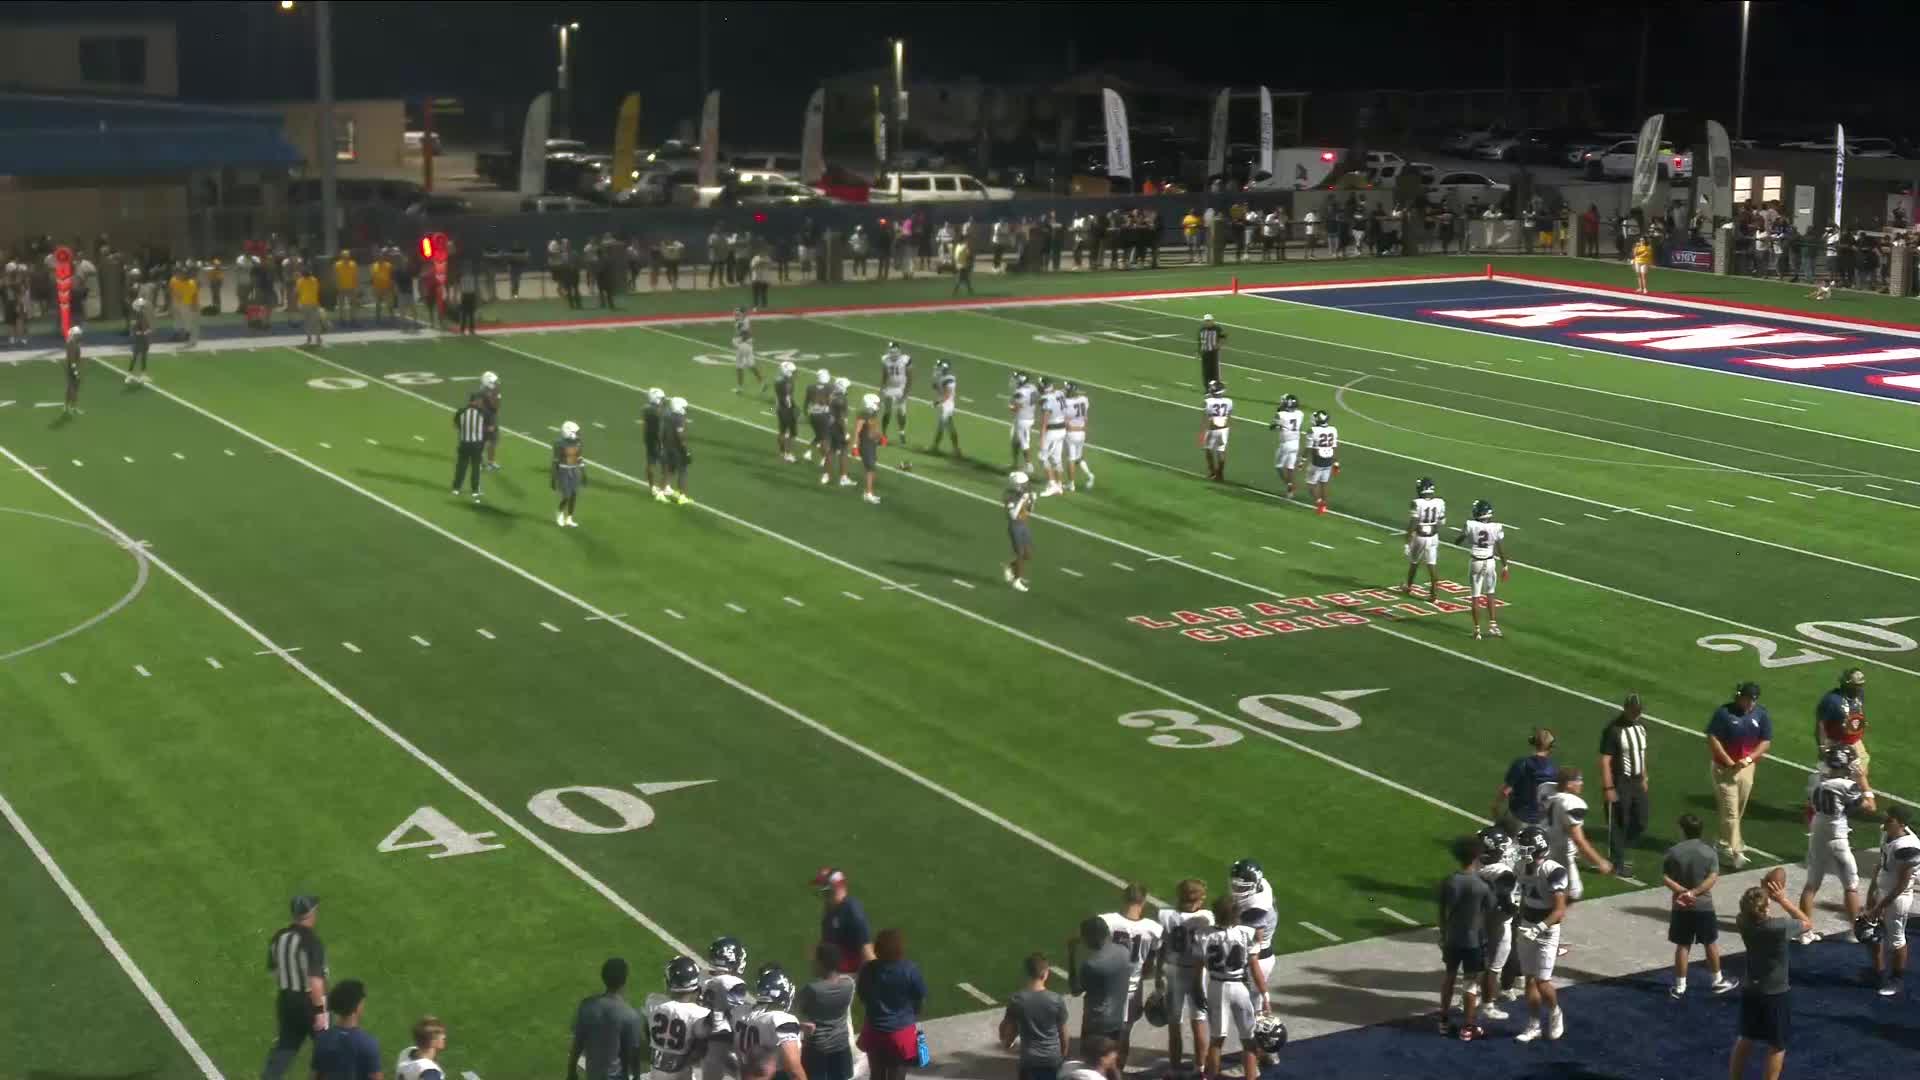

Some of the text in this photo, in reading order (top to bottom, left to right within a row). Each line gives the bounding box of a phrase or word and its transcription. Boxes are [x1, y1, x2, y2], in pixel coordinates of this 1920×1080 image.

[1212, 404, 1228, 417] 37
[1289, 419, 1298, 432] 7
[1319, 433, 1334, 448] 22
[1423, 507, 1437, 523] 11
[1477, 530, 1490, 549] 2
[1117, 693, 1362, 749] 30
[377, 785, 656, 860] 40
[651, 1013, 687, 1050] 29
